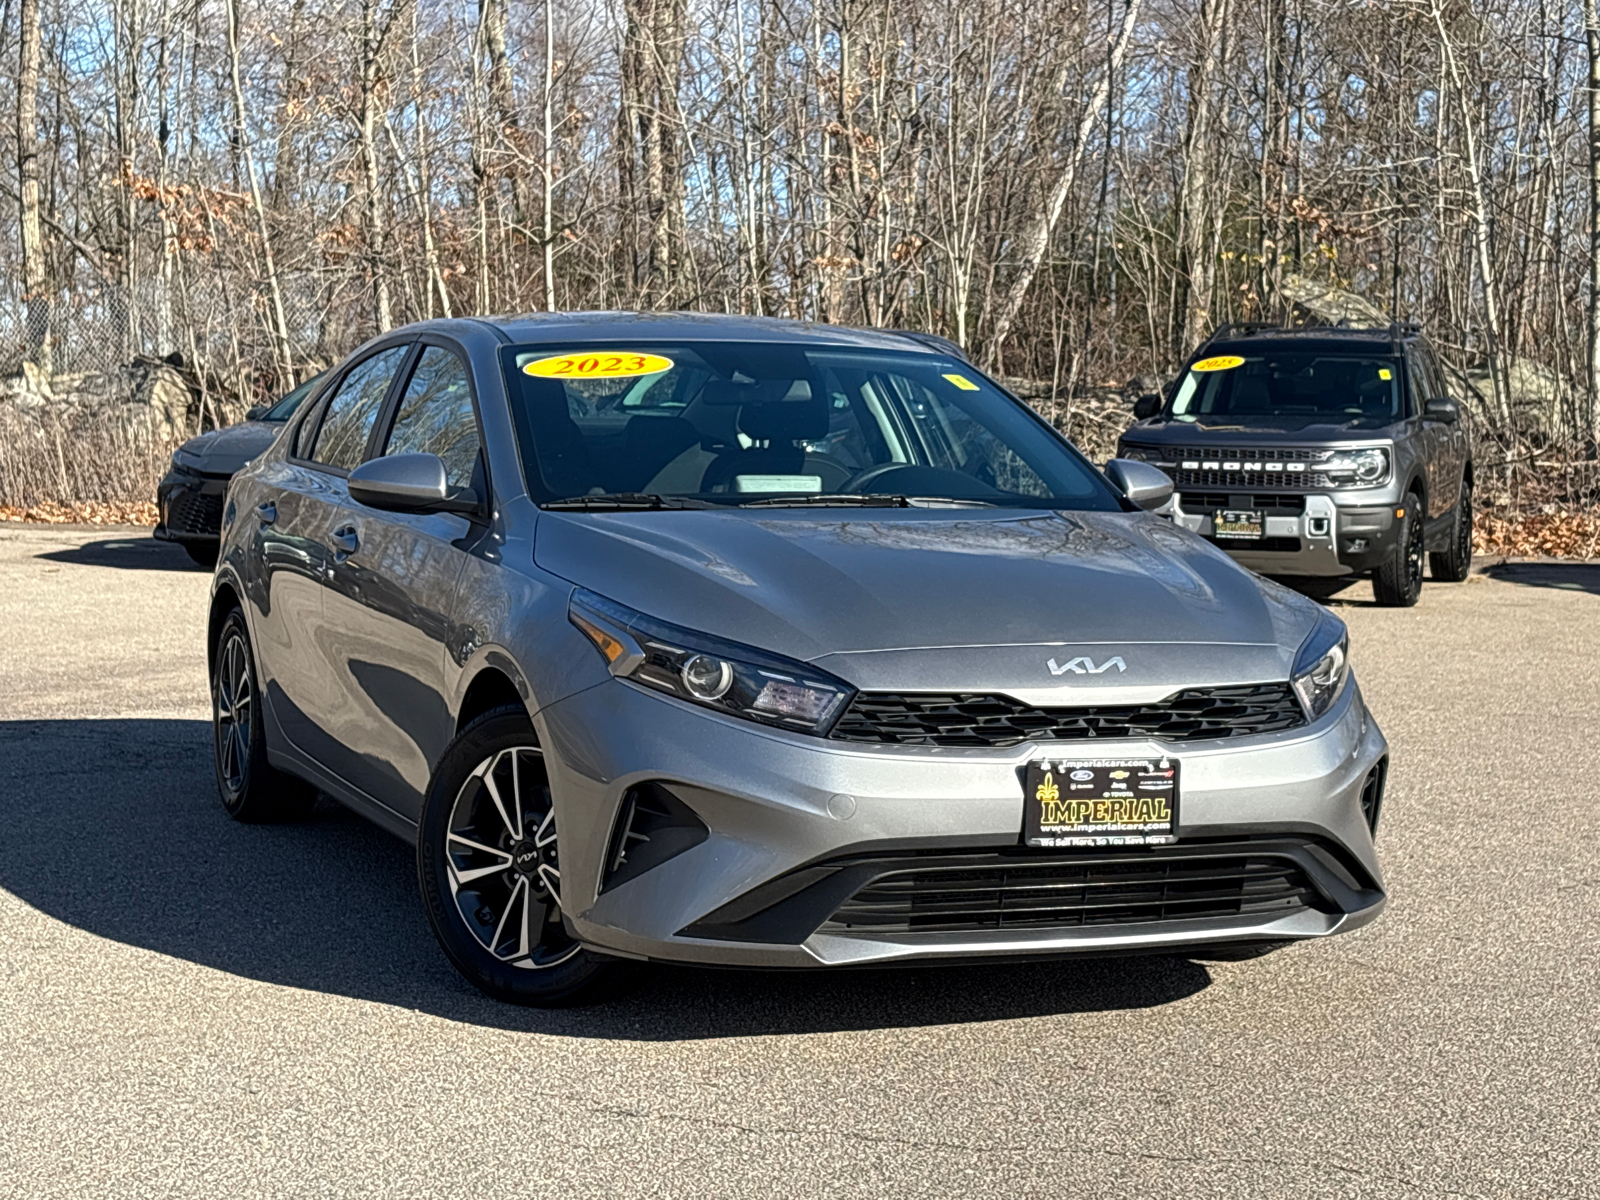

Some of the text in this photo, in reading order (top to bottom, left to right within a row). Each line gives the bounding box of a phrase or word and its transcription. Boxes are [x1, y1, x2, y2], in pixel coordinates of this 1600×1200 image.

[552, 356, 647, 374] 2023
[1198, 358, 1236, 370] 2025
[1181, 461, 1305, 471] BRONCO
[1046, 656, 1127, 676] KIA
[1040, 798, 1171, 824] IMPERIAL
[1040, 822, 1171, 833] www.imperialcars.com
[1040, 838, 1055, 847] We
[1055, 838, 1072, 847] Sell
[1108, 837, 1124, 845] You
[1145, 836, 1166, 844] More
